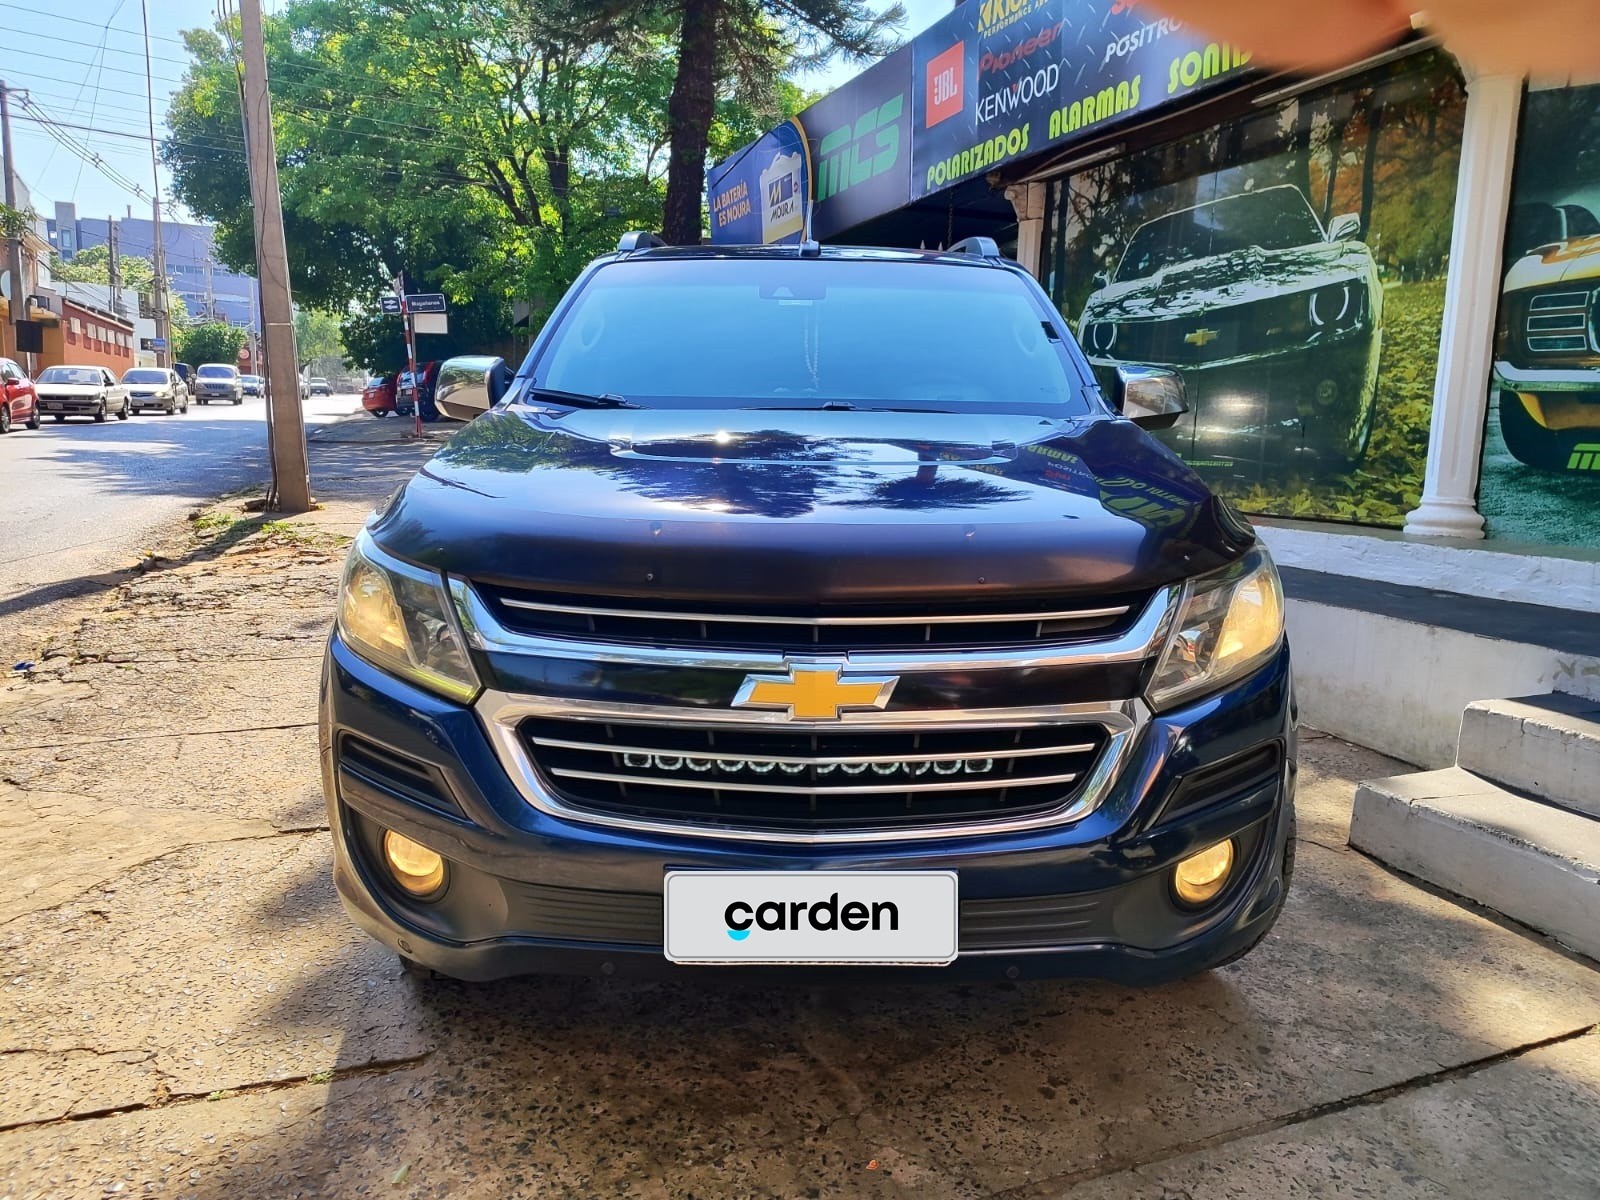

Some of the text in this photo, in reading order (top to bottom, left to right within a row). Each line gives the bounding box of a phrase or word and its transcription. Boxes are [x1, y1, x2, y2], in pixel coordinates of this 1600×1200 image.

[976, 21, 1064, 80] Pioneer
[1105, 17, 1184, 63] POSITRO
[933, 66, 958, 106] JBL
[975, 63, 1059, 126] KENWOOD
[818, 95, 903, 202] MCS
[926, 123, 1031, 190] POLARIZADOS
[1047, 75, 1141, 140] ALARMAS
[713, 178, 748, 212] LA BATERÍA
[718, 199, 751, 227] ES MOURA
[770, 200, 794, 223] MOURA
